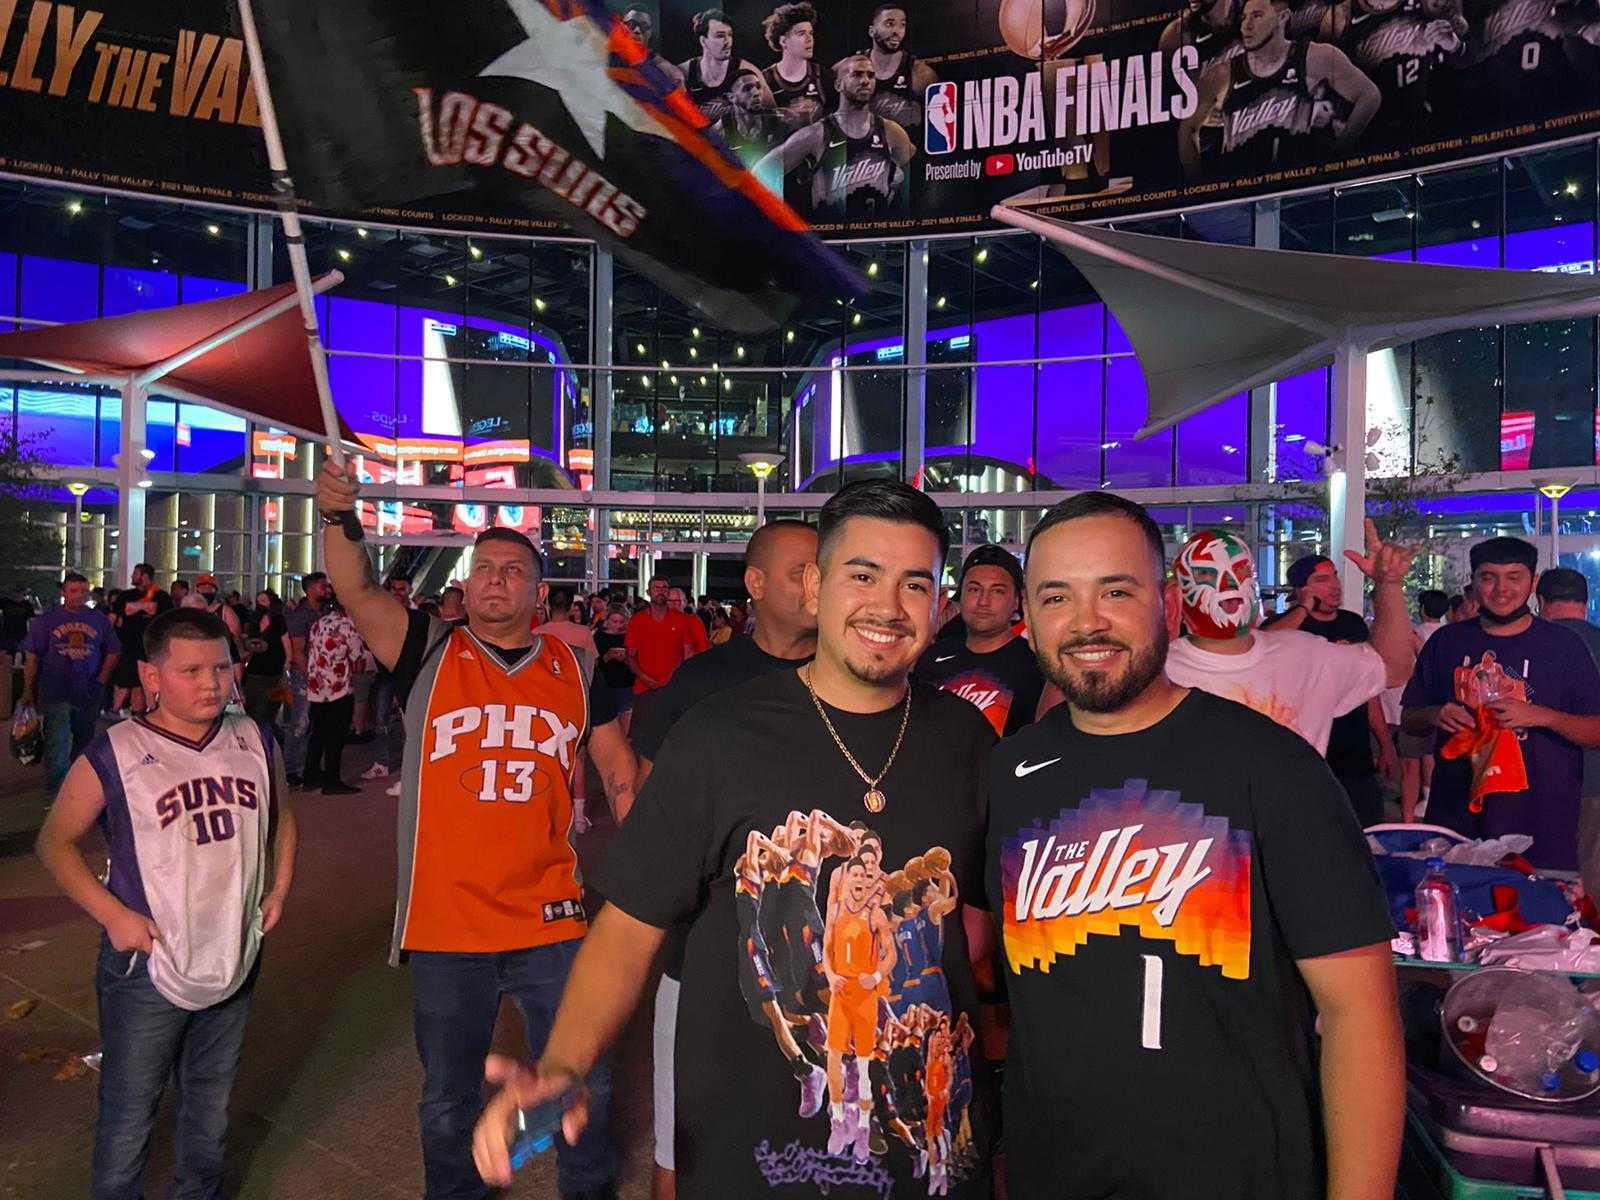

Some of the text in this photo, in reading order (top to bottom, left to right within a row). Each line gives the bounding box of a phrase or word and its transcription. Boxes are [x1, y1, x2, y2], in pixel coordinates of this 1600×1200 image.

[88, 42, 171, 112] THE
[1397, 58, 1419, 87] 12
[1521, 41, 1541, 71] 0
[963, 71, 1046, 150] NBA
[1055, 45, 1199, 138] FINALS
[1231, 96, 1297, 137] Valley
[54, 165, 64, 175] IN
[71, 168, 100, 180] RALLY
[102, 172, 119, 182] THE
[121, 175, 155, 187] VALLEY
[202, 186, 232, 197] FINALS
[503, 122, 646, 238] SUNS
[832, 158, 886, 191] Valley
[925, 161, 969, 181] Presented
[970, 159, 982, 180] by
[1036, 203, 1086, 216] RELENTLESS
[1092, 194, 1142, 209] EVERYTHING
[1143, 188, 1177, 201] COUNTS
[1183, 182, 1219, 195] LOCKED
[1220, 180, 1230, 190] IN
[1236, 176, 1263, 188] RALLY
[1264, 172, 1282, 183] THE
[1284, 166, 1317, 179] VALLEY
[1346, 158, 1366, 169] NBA
[1367, 151, 1400, 164] FINALS
[1411, 138, 1463, 156] TOGETHER
[1471, 123, 1536, 145] RELENTLESS
[401, 208, 434, 219] COUNTS
[442, 213, 475, 222] LOCKED
[475, 215, 484, 223] IN
[489, 217, 512, 226] RALLY
[514, 219, 530, 227] THE
[531, 220, 558, 229] VALLEY
[806, 223, 834, 232] OCKED
[850, 221, 872, 231] RALLY
[873, 220, 888, 229] THE
[889, 218, 915, 229] VALLEY
[938, 215, 955, 225] NBA
[956, 214, 982, 225] FINALS
[429, 703, 580, 770] PHX
[477, 759, 537, 803] 13
[156, 775, 258, 832] SUNS
[193, 808, 236, 846] 10
[1016, 823, 1214, 927] THE Valley
[1141, 954, 1163, 1050] 1
